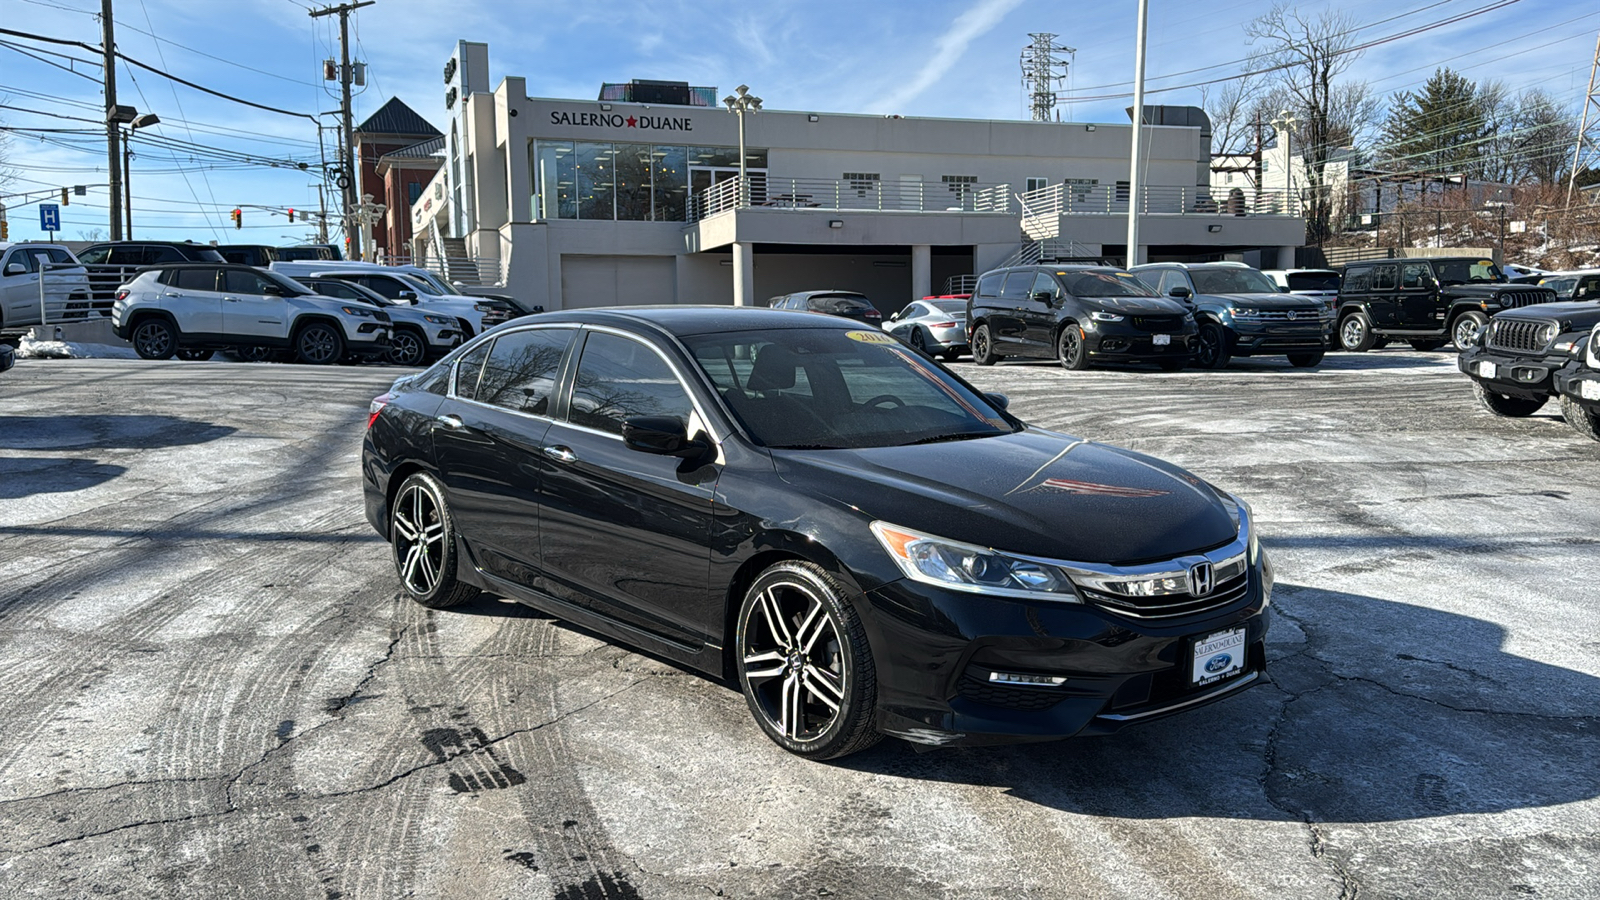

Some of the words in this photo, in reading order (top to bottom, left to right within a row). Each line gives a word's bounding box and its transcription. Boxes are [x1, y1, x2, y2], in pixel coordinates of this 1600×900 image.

[551, 111, 624, 128] SALERNO
[639, 116, 693, 131] DUANE
[44, 210, 55, 223] H
[856, 333, 890, 342] 2016
